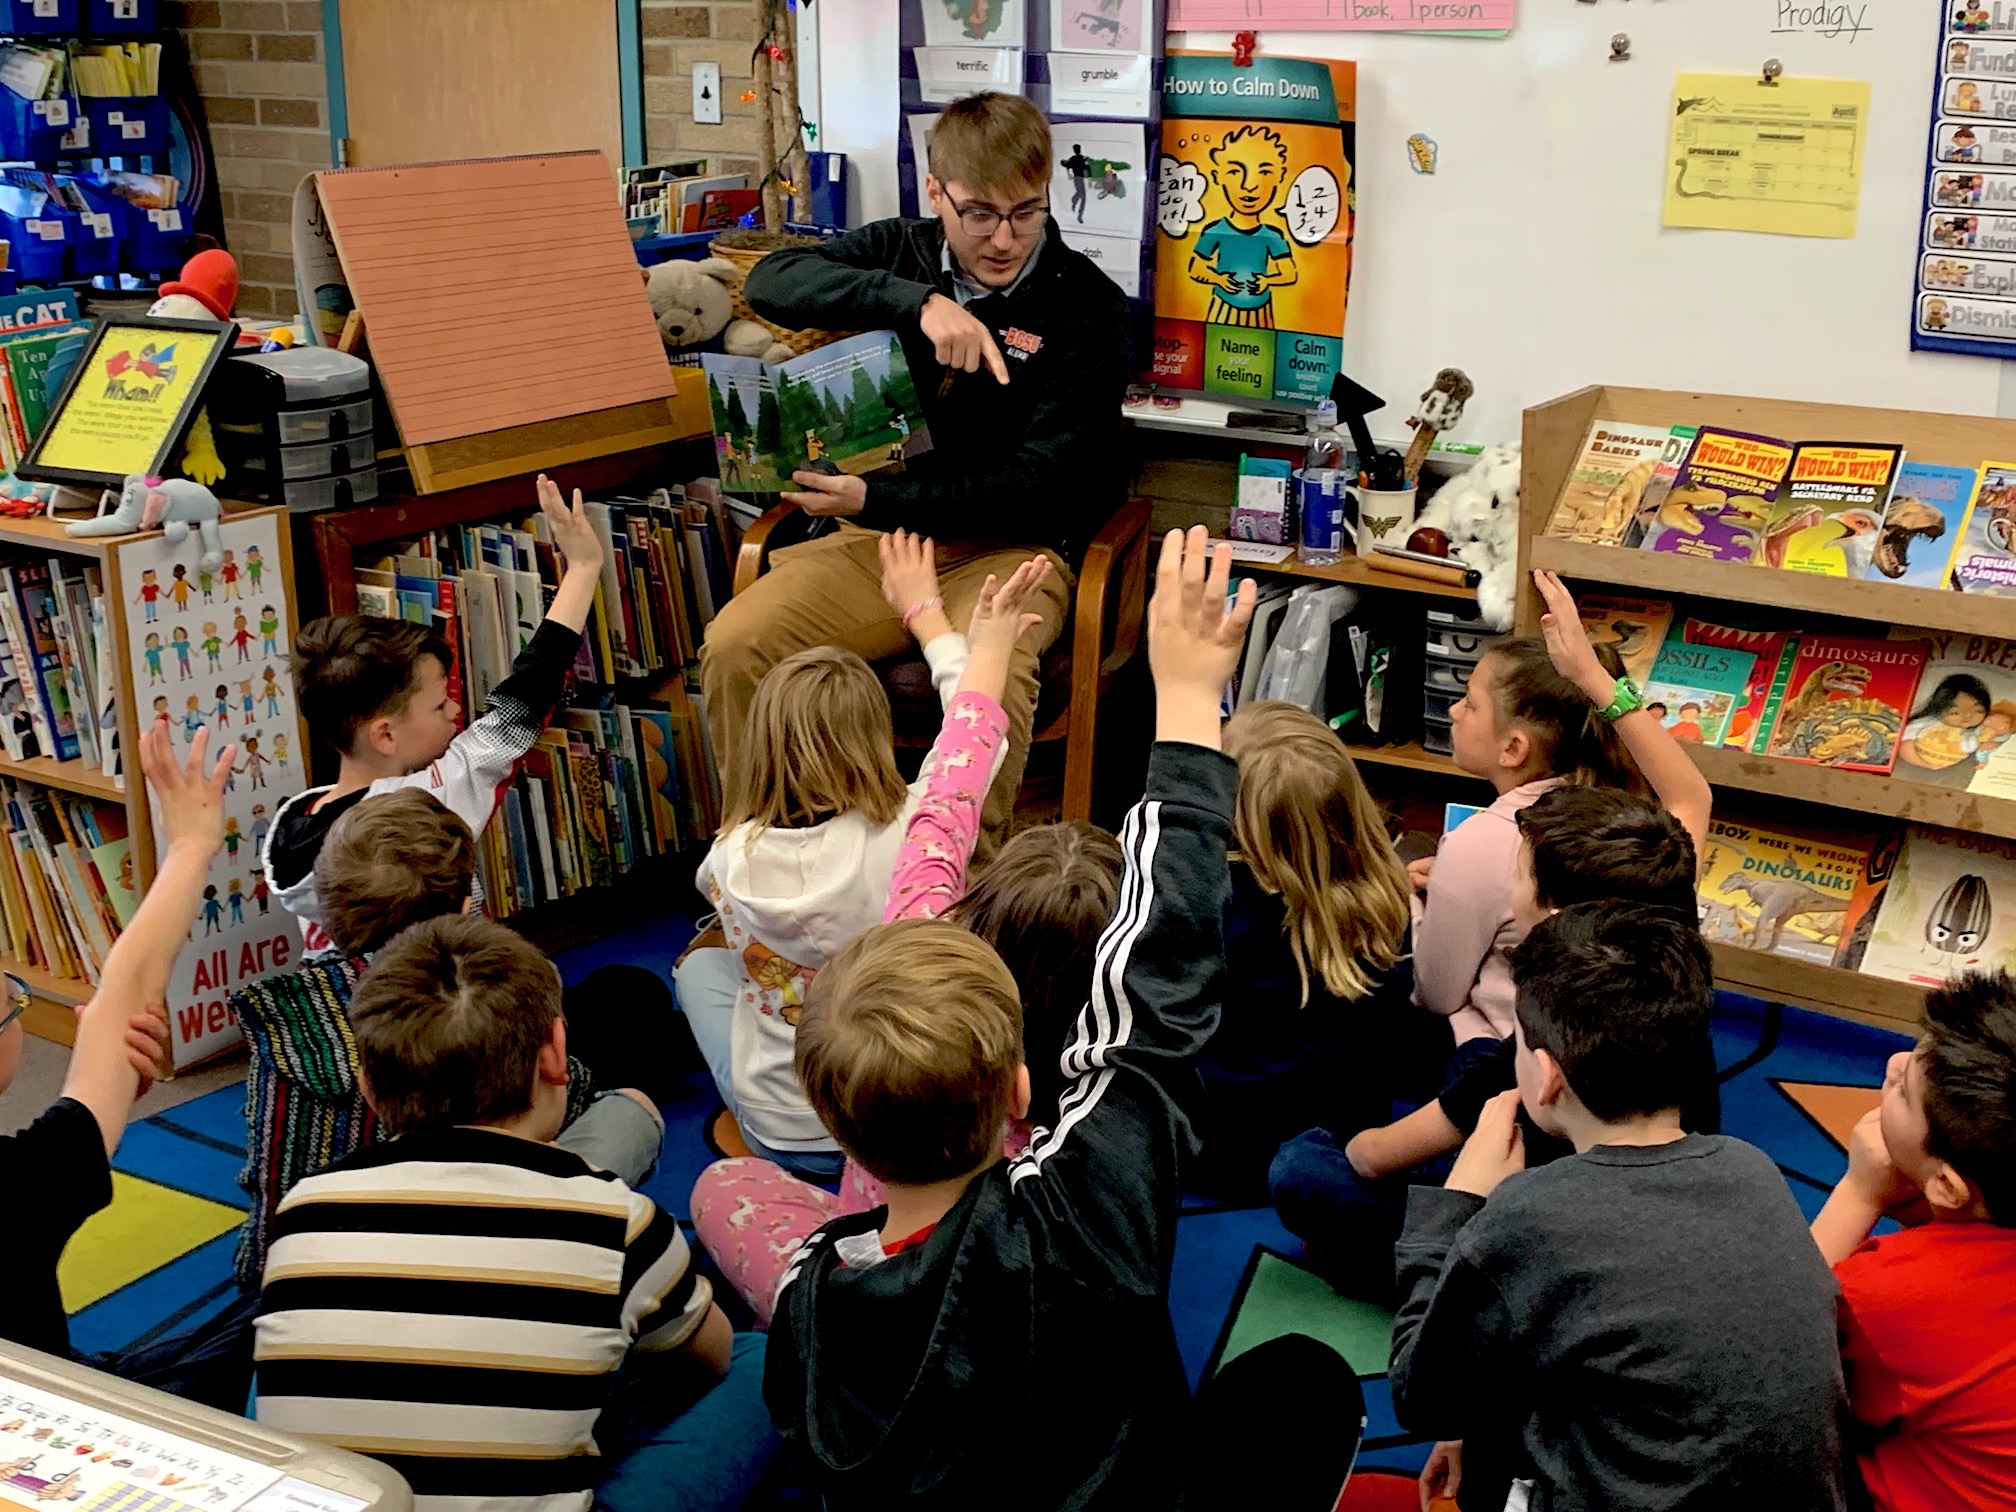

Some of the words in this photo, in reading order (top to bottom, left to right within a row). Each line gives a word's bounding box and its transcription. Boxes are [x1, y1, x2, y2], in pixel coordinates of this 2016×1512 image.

[1419, 4, 1484, 24] person
[1777, 0, 1867, 44] Prodigy
[956, 60, 989, 72] terrific
[1081, 68, 1118, 82] grumble
[1163, 75, 1204, 95] How
[1208, 78, 1228, 95] to
[1232, 77, 1275, 97] Calm
[1278, 78, 1320, 100] Down
[1687, 147, 1715, 157] SPRING
[1716, 148, 1740, 157] BREAK
[1164, 167, 1173, 176] I
[1160, 195, 1183, 205] do
[1163, 203, 1188, 223] it!
[16, 301, 68, 328] CAT
[18, 349, 47, 363] Ten
[1221, 338, 1260, 357] Name
[1294, 339, 1326, 357] Calm
[1165, 353, 1189, 363] your
[1228, 354, 1251, 367] your
[1288, 354, 1331, 374] down:
[1153, 361, 1182, 376] signal
[1216, 366, 1262, 388] feeling
[1734, 441, 1760, 452] WHO
[1832, 450, 1859, 460] WHO
[1696, 441, 1745, 467] WOULD
[1745, 453, 1787, 478] WIN?
[1798, 456, 1848, 478] WOULD
[1848, 460, 1889, 483] WIN?
[1790, 490, 1845, 501] SECRETARY
[1845, 494, 1875, 503] BIRD
[1791, 482, 1860, 494] RATTLESNAKE
[1656, 648, 1732, 673] OSSILS
[1802, 639, 1921, 667] dinosaurs
[1715, 823, 1752, 842] BOY,
[1757, 836, 1790, 851] WERE
[1794, 843, 1813, 855] WE
[1817, 848, 1867, 866] WRONG
[1742, 856, 1853, 891] DINOSAURS
[1815, 861, 1862, 876] ABOUT
[192, 948, 228, 997] All
[238, 934, 290, 981] Are
